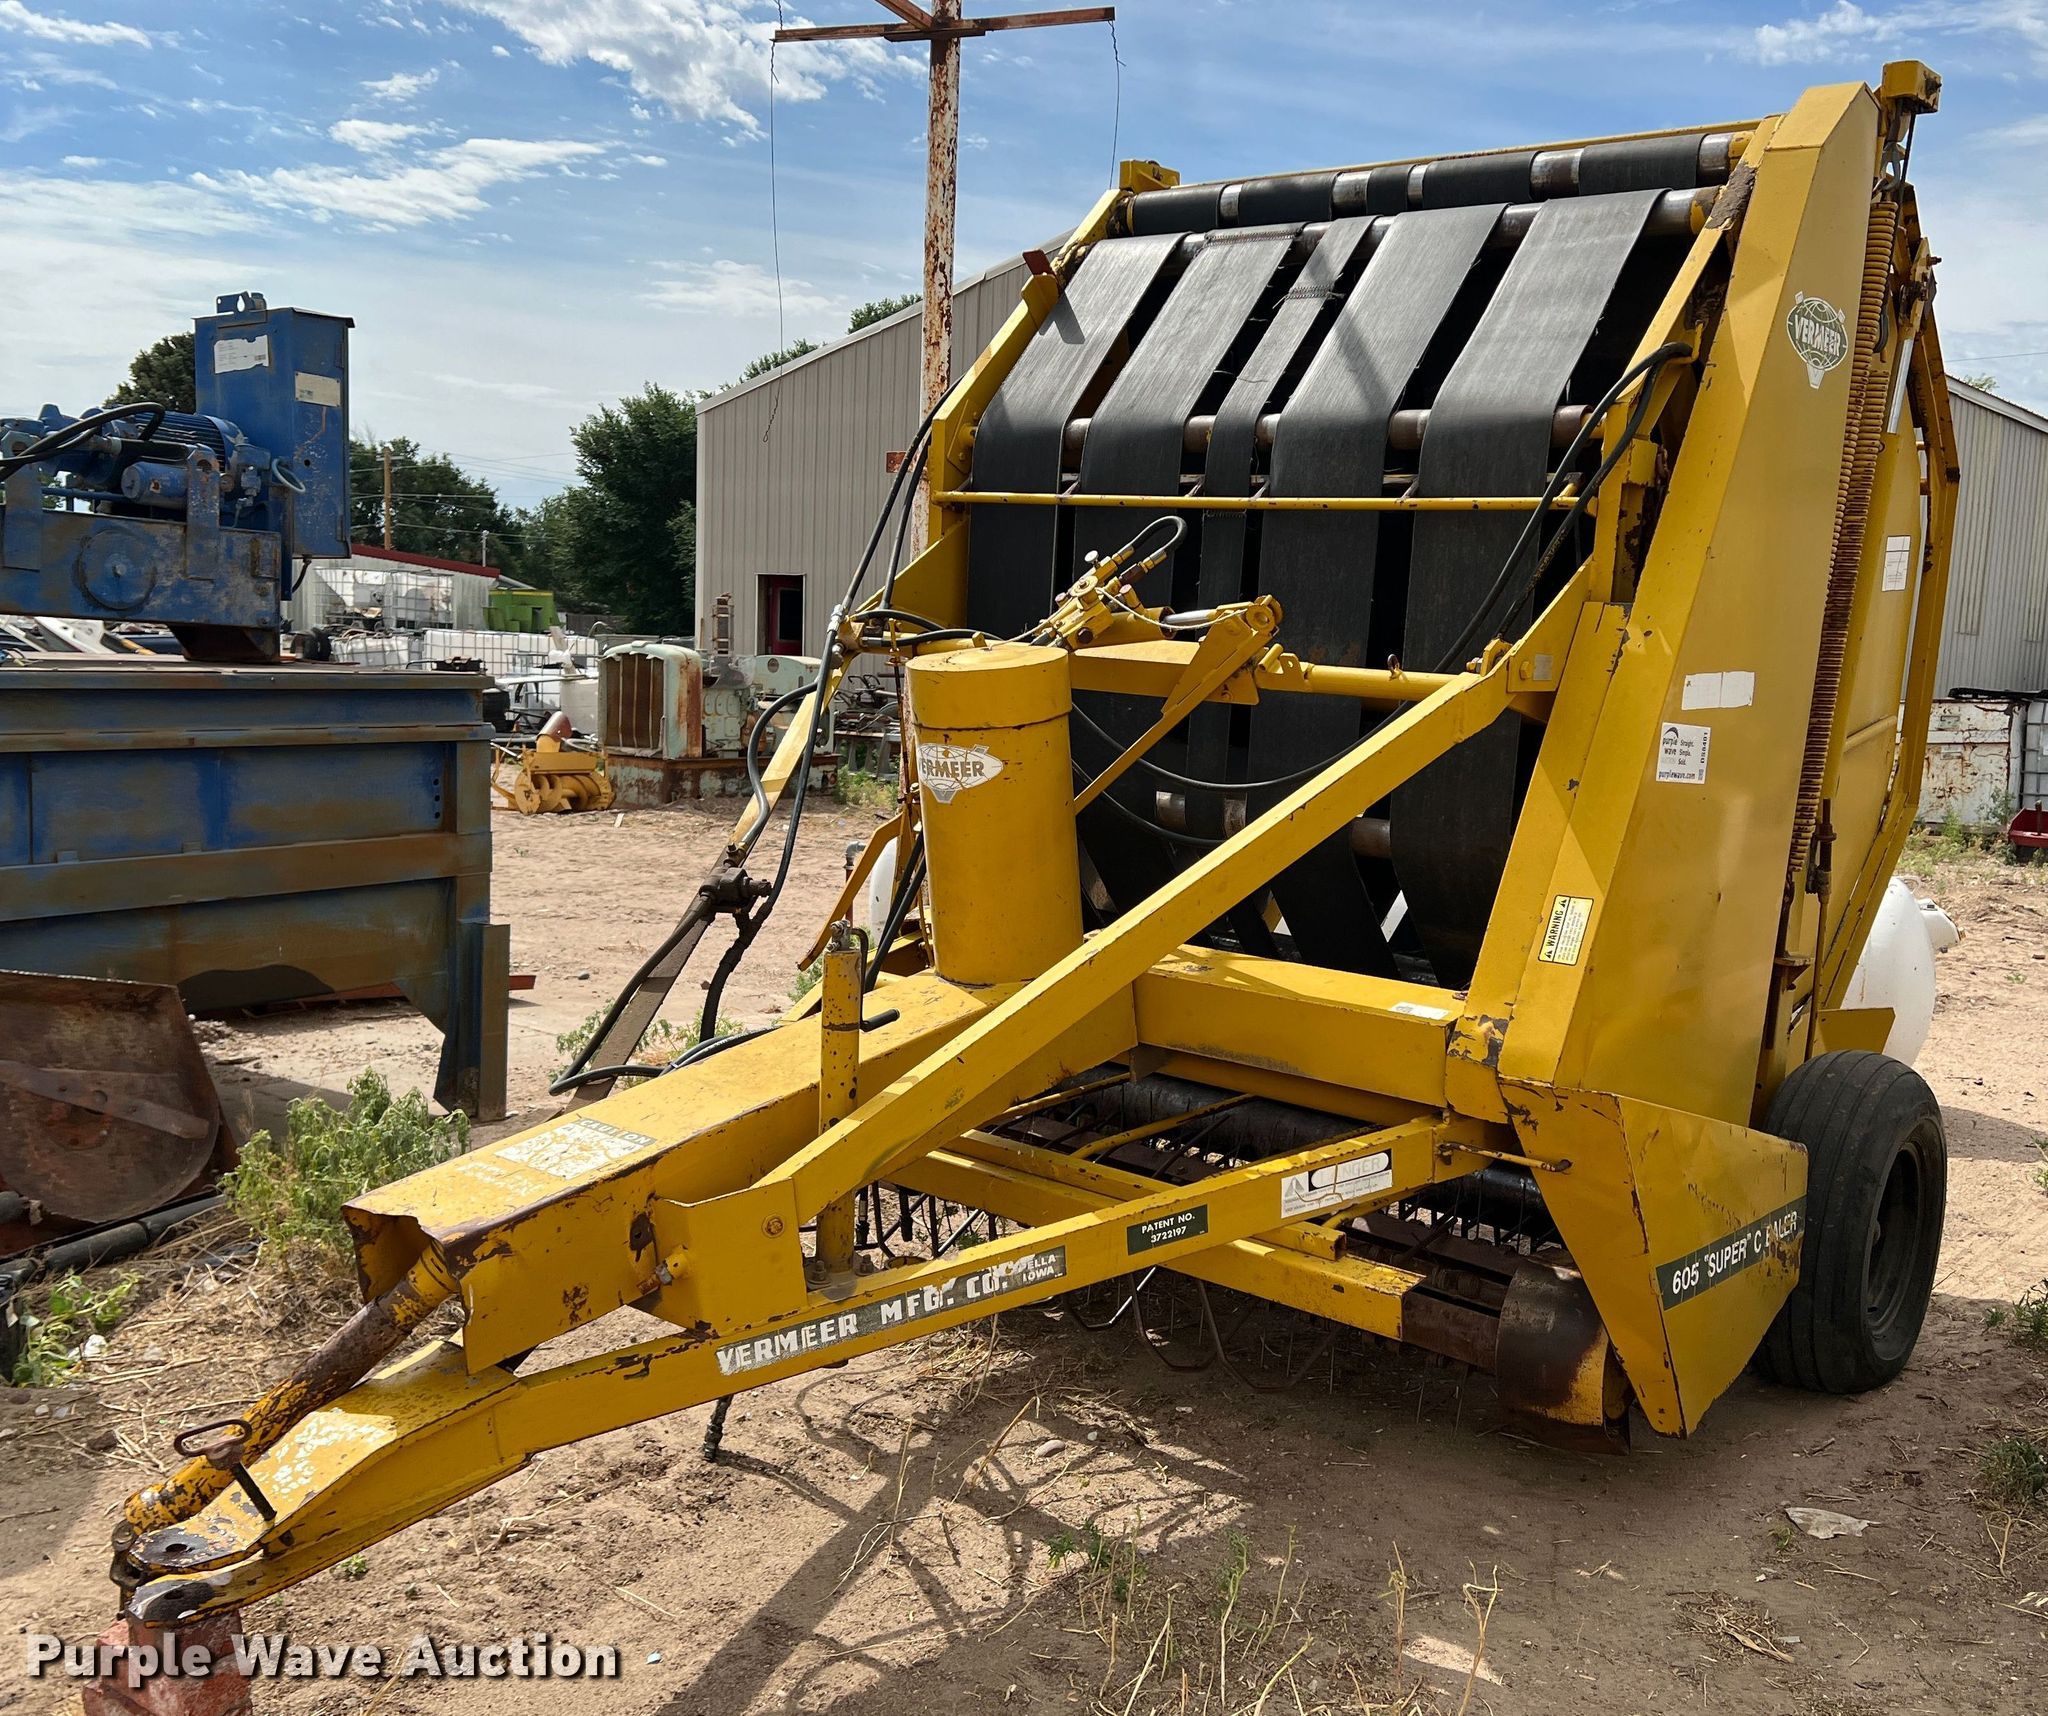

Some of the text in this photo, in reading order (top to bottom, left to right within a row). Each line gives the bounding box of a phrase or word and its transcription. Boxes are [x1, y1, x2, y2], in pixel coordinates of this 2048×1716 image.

[1795, 314, 1841, 357] VERMEER
[920, 758, 985, 778] ERMEER
[1546, 910, 1563, 946] WARNING
[1141, 1212, 1196, 1234] PATENT NO.
[1150, 1226, 1187, 1243] 3722197
[1019, 1254, 1057, 1273] ELLA
[1672, 1262, 1700, 1294] 605
[1753, 1230, 1762, 1253] C
[1022, 1266, 1055, 1282] IOWA
[716, 1272, 1008, 1375] VERMEER MFG. CO.
